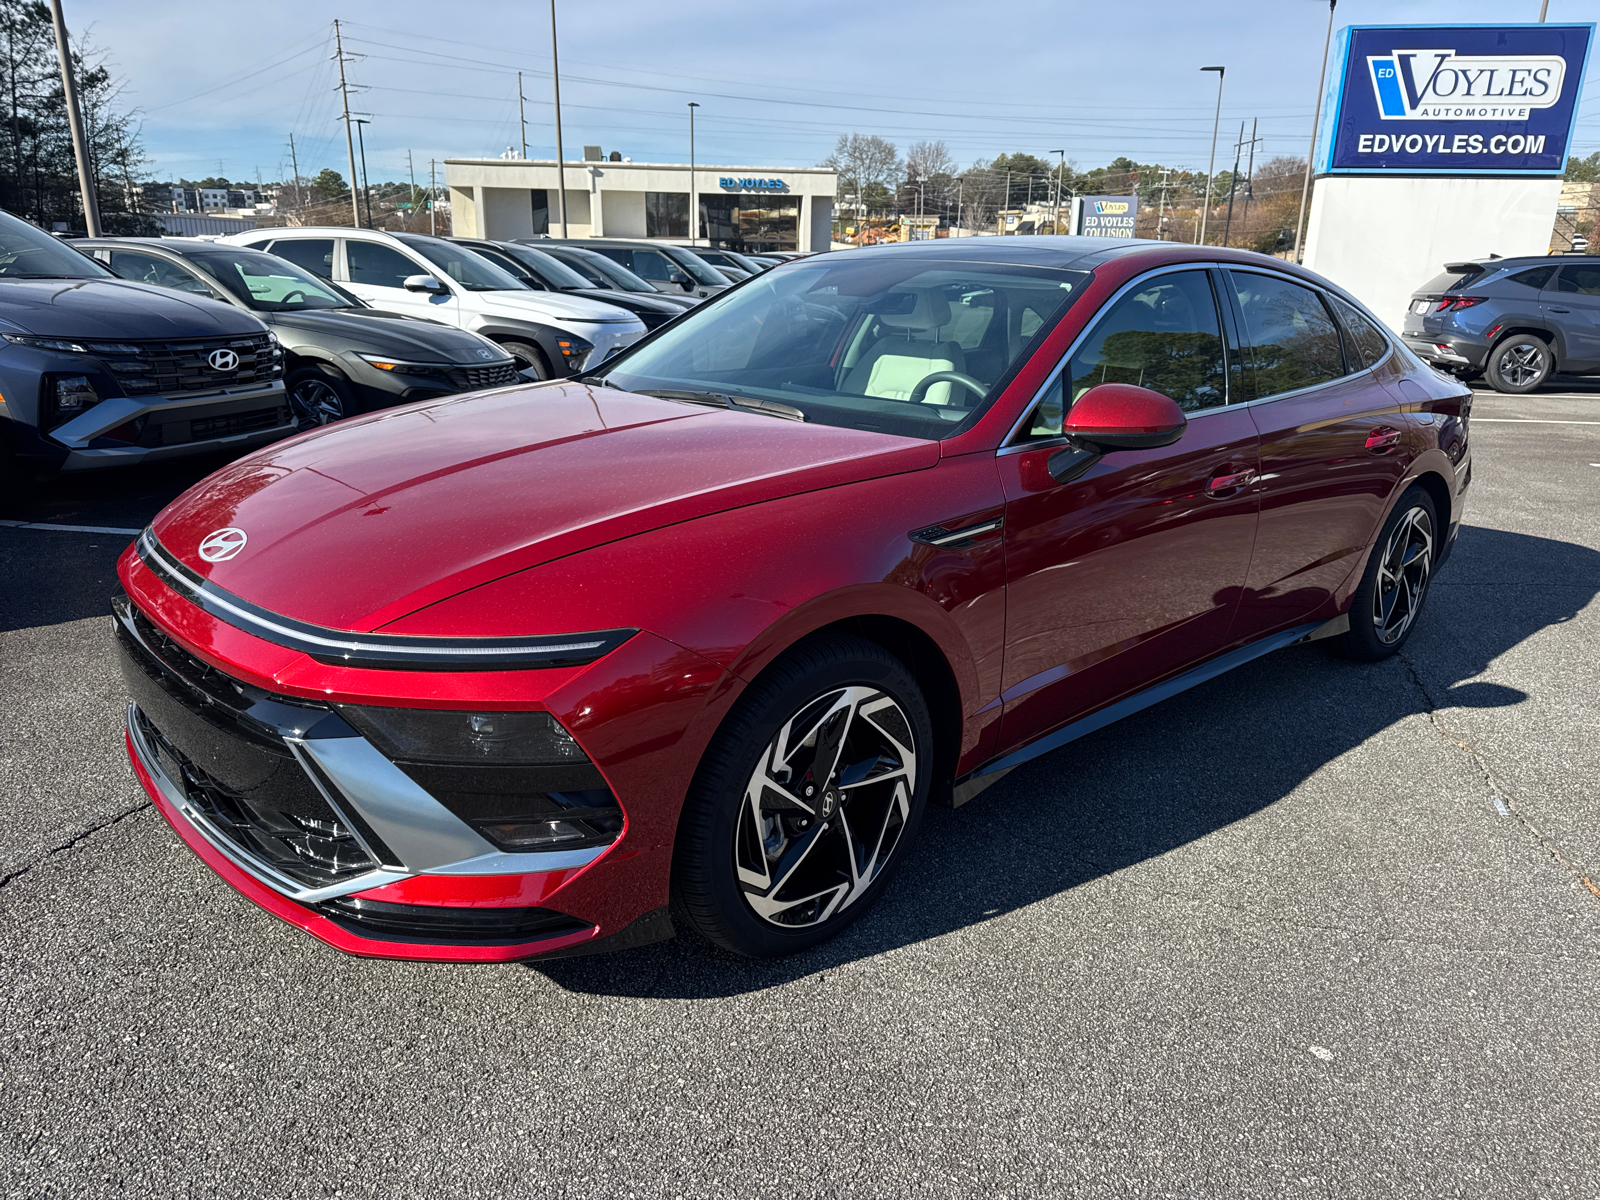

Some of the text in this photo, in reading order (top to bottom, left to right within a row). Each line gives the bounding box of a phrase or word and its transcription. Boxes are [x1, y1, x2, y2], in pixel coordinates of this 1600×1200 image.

[1377, 53, 1551, 110] ED VOYLES
[1420, 107, 1527, 117] AUTOMOTIVE
[1357, 134, 1546, 154] EDVOYLES.COM
[719, 177, 783, 189] ED VOYLES
[1085, 217, 1134, 226] ED VOYLES
[1084, 228, 1133, 238] COLLISION
